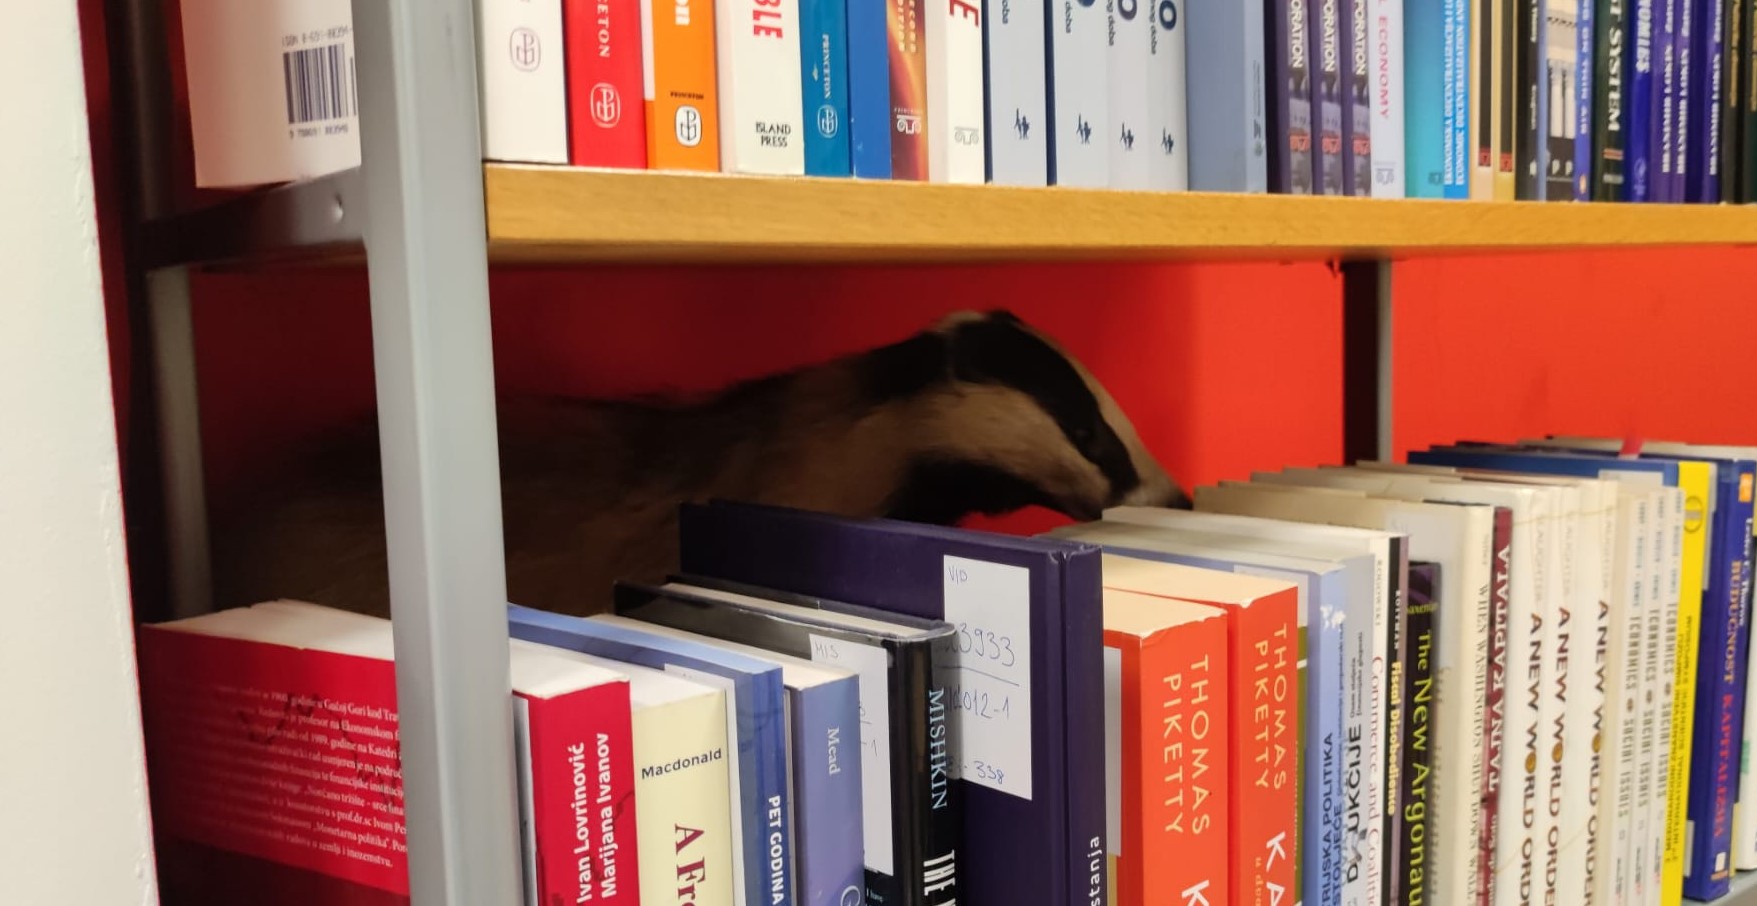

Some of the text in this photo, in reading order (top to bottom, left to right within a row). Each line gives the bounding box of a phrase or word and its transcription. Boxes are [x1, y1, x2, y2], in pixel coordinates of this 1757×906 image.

[823, 33, 833, 99] PRINCETON
[1379, 16, 1389, 118] ECONOMY
[1608, 27, 1622, 131] SYSTEM
[756, 121, 791, 136] ISLAND
[760, 134, 788, 148] PRESS
[1417, 628, 1433, 671] The
[1493, 545, 1510, 691] KAPITALA
[1530, 613, 1543, 634] A
[1558, 607, 1571, 628] A
[1391, 661, 1402, 708] Fiscal
[1527, 640, 1542, 711] NEW
[1555, 633, 1570, 702] NEW
[1594, 626, 1608, 694] NEW
[1254, 640, 1269, 788] PIKETTY
[1274, 624, 1287, 790] THOMAS
[1367, 656, 1384, 775] Commerce
[1411, 677, 1433, 752] New
[641, 748, 723, 780] Macdonald
[827, 726, 841, 776] Mead
[927, 688, 948, 810] MISHKIN
[1163, 673, 1184, 834] PIKETTY
[1190, 654, 1211, 835] THOMAS
[1321, 733, 1333, 826] POLITIKA
[1386, 710, 1401, 816] Disobedience
[567, 741, 593, 904] Ivan Lovrinović
[596, 733, 618, 899] Marijana Ivanov
[1368, 783, 1380, 820] and
[674, 823, 705, 852] A
[768, 795, 785, 905] PET GODINA
[923, 850, 955, 896] THE
[1520, 838, 1533, 906] ORD
